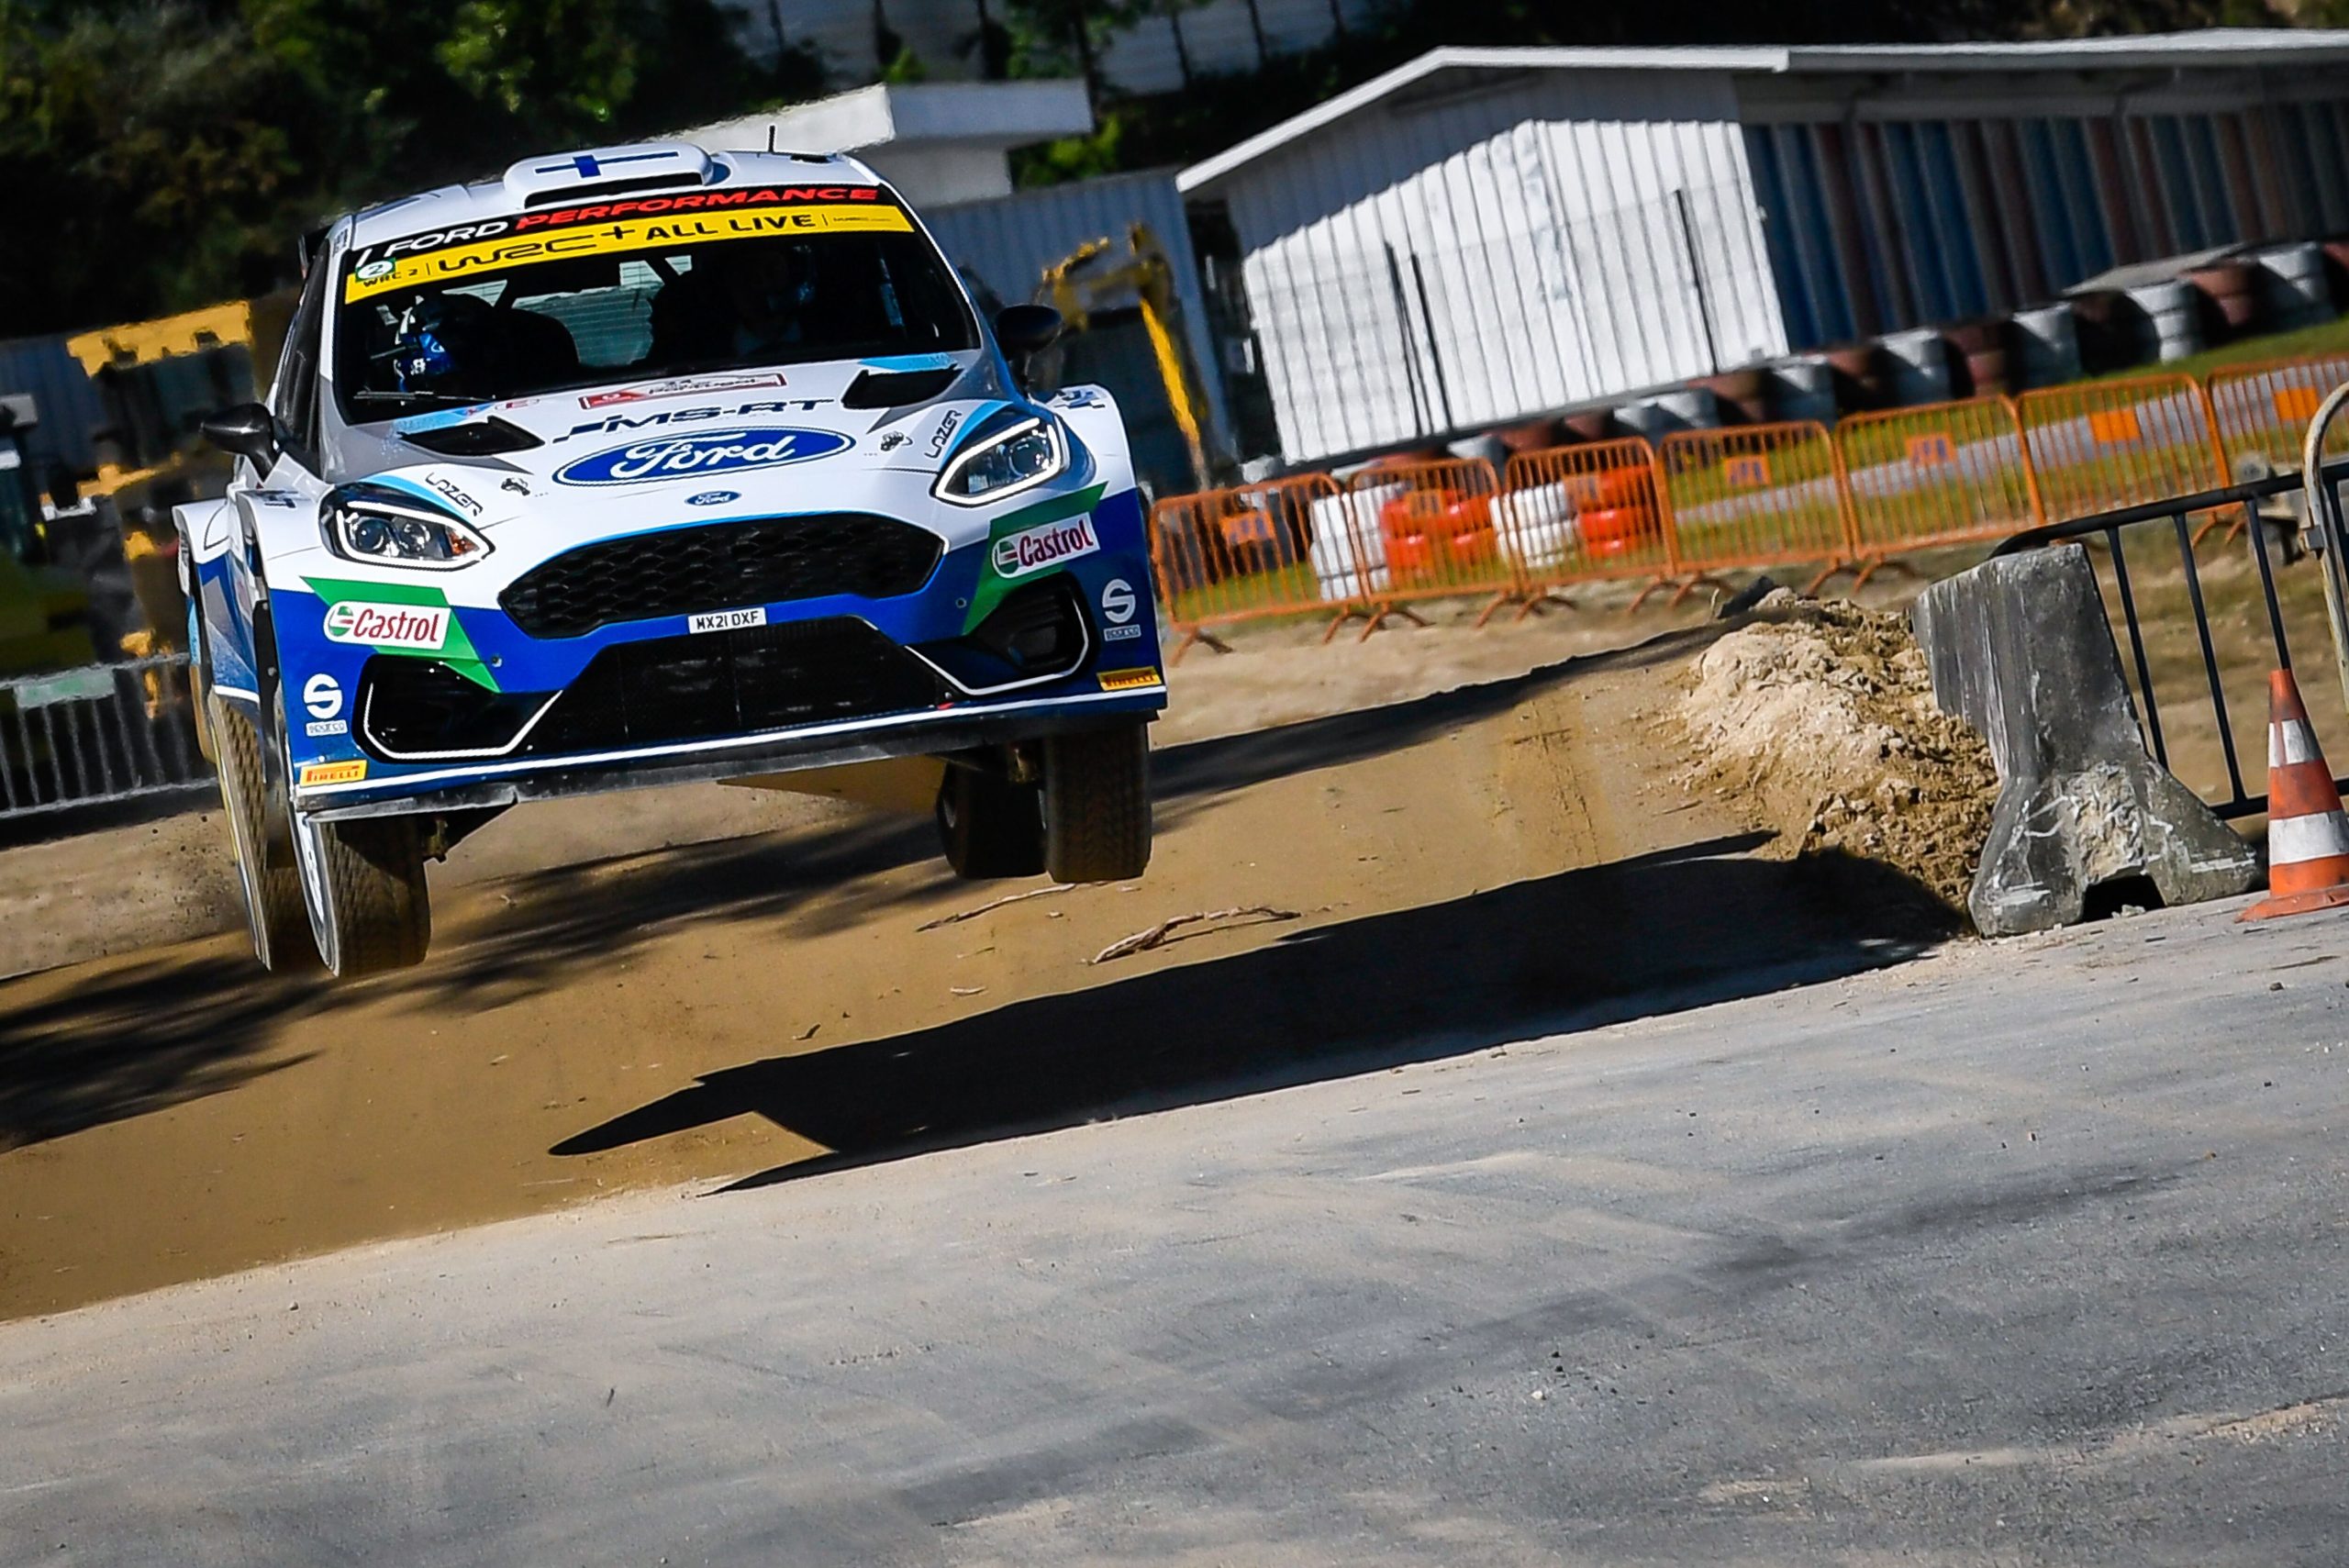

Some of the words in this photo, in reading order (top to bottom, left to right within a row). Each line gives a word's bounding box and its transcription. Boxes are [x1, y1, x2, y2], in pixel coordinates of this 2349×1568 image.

[384, 221, 509, 258] FORD
[516, 189, 879, 230] PERFORMANCE
[646, 222, 718, 240] ALL
[729, 214, 817, 231] LIVE
[368, 264, 384, 276] 2
[609, 432, 798, 479] Ford
[694, 492, 731, 505] Ford
[1019, 519, 1095, 567] Castrol
[353, 608, 440, 643] Castrol
[306, 764, 361, 783] PIRELLI
